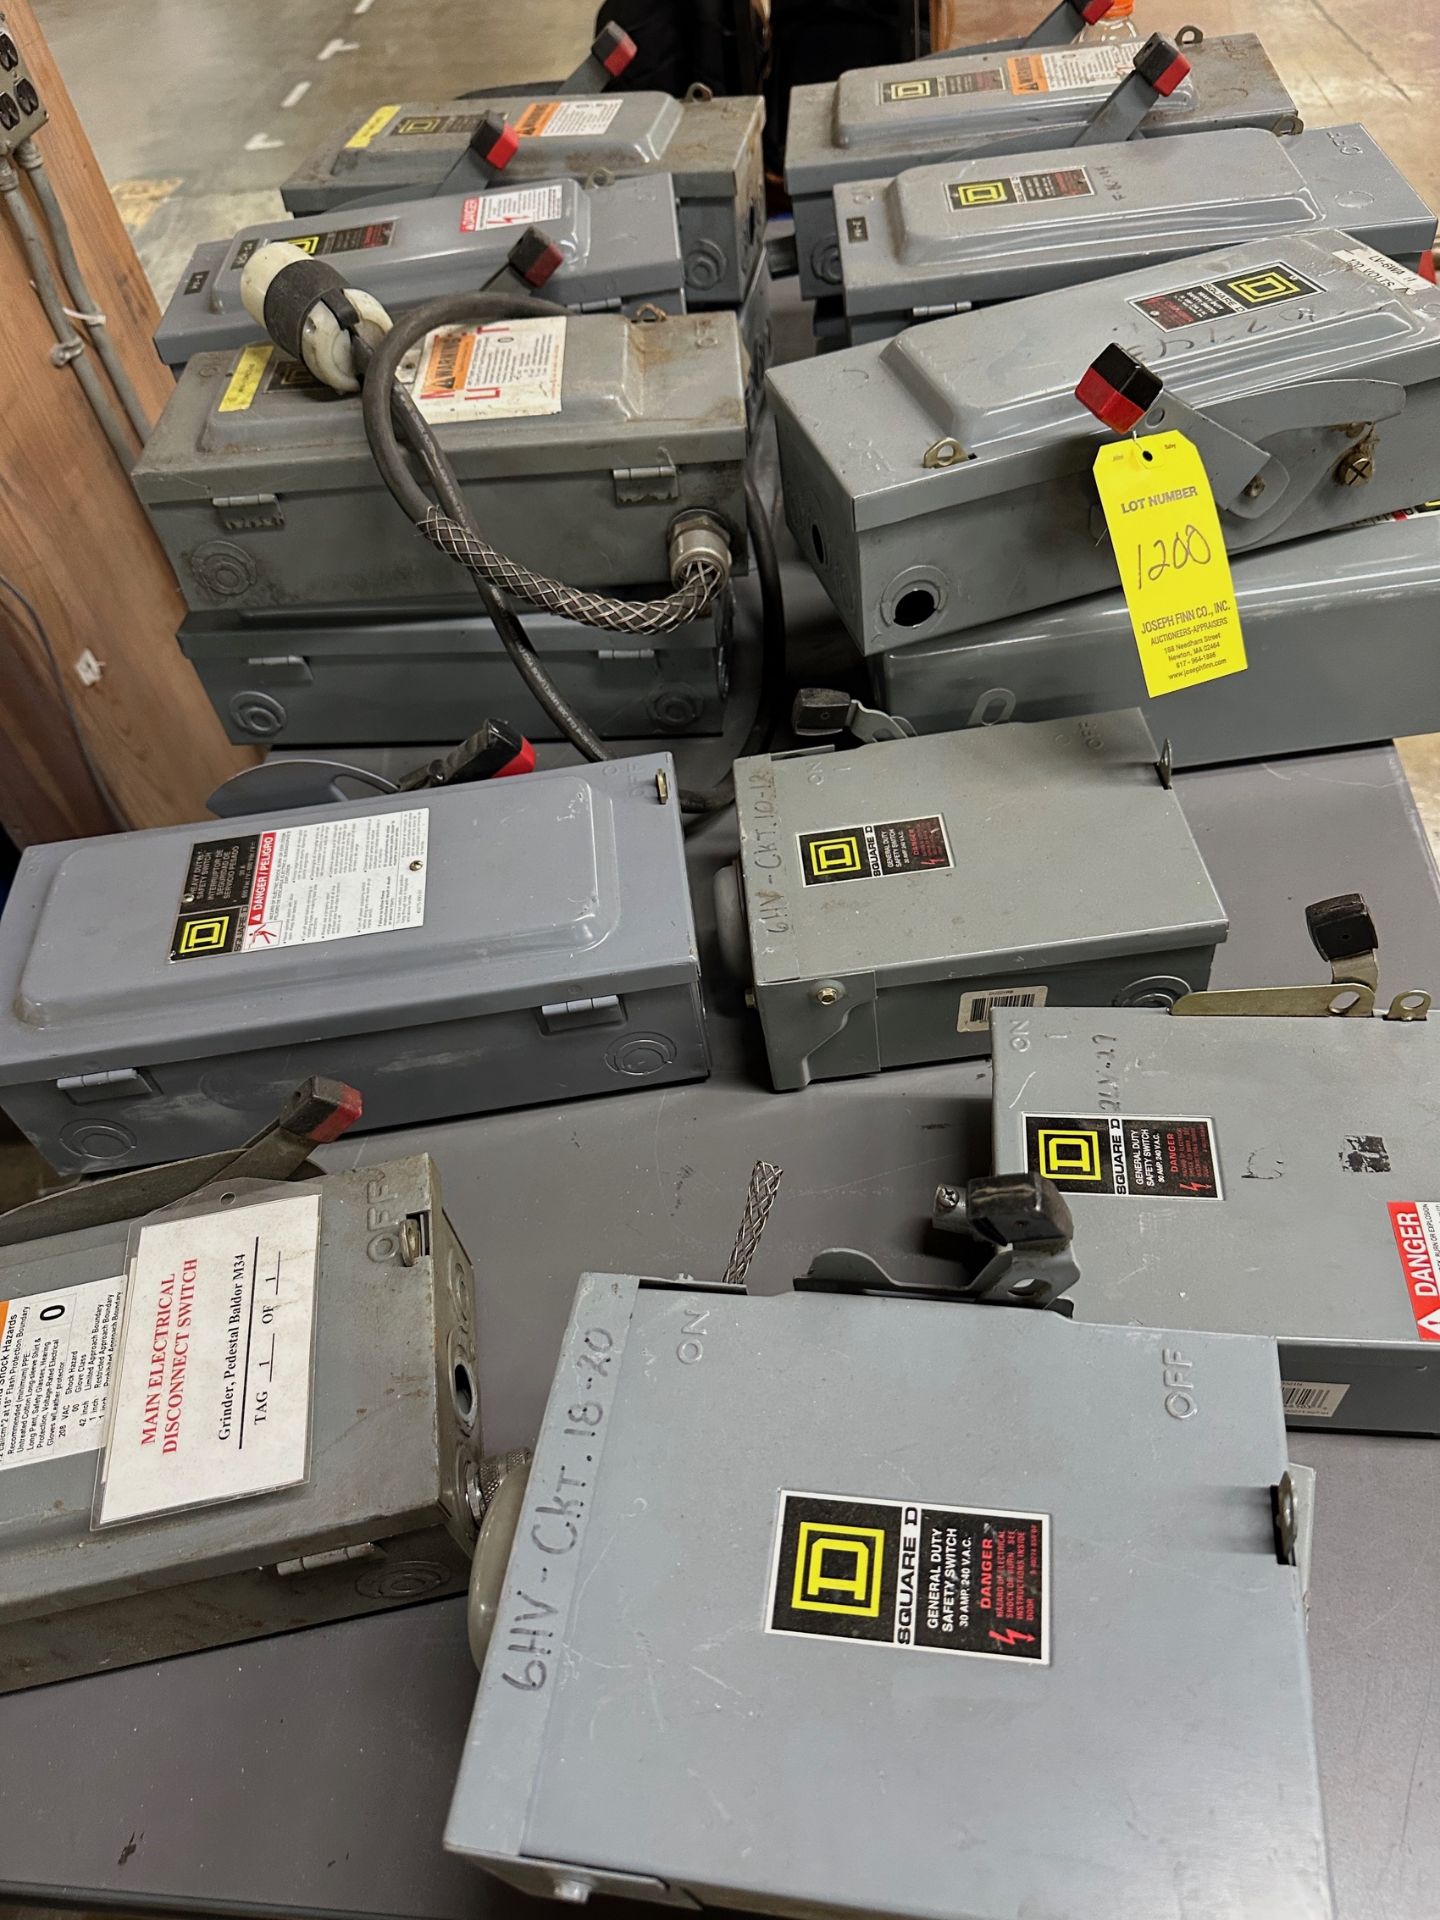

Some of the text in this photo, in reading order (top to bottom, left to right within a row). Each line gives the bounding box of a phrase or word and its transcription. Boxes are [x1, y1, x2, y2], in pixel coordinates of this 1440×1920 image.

[1202, 283, 1238, 308] SQUARE
[1121, 486, 1198, 514] LOT NUMBER
[1137, 524, 1212, 590] 1200
[1141, 600, 1231, 634] JOSEPH FINN CO., INC.
[1150, 617, 1228, 646] AUCTIONEERS-APPRAISERS
[1168, 650, 1192, 662] Newton,
[1193, 646, 1203, 656] MA
[1176, 638, 1203, 650] Needham
[1203, 632, 1221, 643] Street
[1168, 658, 1227, 680] www.josephfinn.com
[1176, 661, 1186, 669] 617
[864, 825, 881, 878] SQUARE D
[253, 877, 267, 911] DANGER
[261, 836, 274, 872] PELIGRO
[234, 915, 248, 952] SQUARE
[1110, 1118, 1129, 1196] SQUARE D
[1131, 1129, 1143, 1184] GENERAL DUTY
[1140, 1128, 1154, 1186] SAFETY SWITCH
[1165, 1132, 1178, 1172] DANGER
[1396, 1212, 1438, 1297] DANGER
[16, 1307, 30, 1338] Boundary
[40, 1305, 65, 1321] 0
[102, 1294, 114, 1323] Boundary
[112, 1292, 123, 1321] Boundary
[2, 1314, 17, 1352] Hazards
[98, 1324, 108, 1355] Approach
[218, 1253, 246, 1441] Grinder, Pedestal Baldor M34
[254, 1275, 277, 1426] TAG 1 OF 1
[676, 1310, 711, 1365] ON
[9, 1339, 22, 1374] Protection
[40, 1341, 51, 1366] Hearing
[78, 1354, 87, 1372] Class
[79, 1304, 104, 1426] 42 inch Limited Approach Boundary
[94, 1356, 105, 1388] Restricted
[140, 1272, 176, 1447] MAIN ELECTRICAL
[162, 1257, 199, 1454] DISCONNECT SWITCH
[6, 1375, 15, 1395] Flash
[17, 1420, 27, 1453] Untreated
[22, 1398, 31, 1419] Cotton
[32, 1343, 41, 1359] Shirt
[36, 1366, 46, 1393] Glasses,
[36, 1339, 59, 1448] Protection, Voltage-Rated Electrical
[58, 1350, 78, 1438] 208 VAC Shock Hazard
[75, 1374, 84, 1393] Glove
[1162, 1347, 1198, 1420] OFF
[32, 1393, 43, 1414] Safety
[47, 1423, 56, 1446] Gloves
[56, 1362, 65, 1390] protector
[90, 1398, 99, 1413] inch
[7, 1404, 21, 1454] Recommended
[26, 1433, 37, 1450] Long
[996, 1529, 1005, 1573] ELECTRICAL
[897, 1507, 919, 1646] SQUARE D
[926, 1527, 943, 1628] GENERAL DUTY
[941, 1527, 957, 1632] SAFETY SWITCH
[959, 1535, 971, 1626] 30 AMP. 240 V.A.C.
[979, 1537, 993, 1608] DANGER
[1015, 1530, 1025, 1619] INSTRUCTIONS INSIDE
[995, 1586, 1004, 1617] HAZARD
[1005, 1591, 1014, 1618] SHOCK
[1026, 1597, 1034, 1620] DOOR
[501, 1591, 559, 1692] 6HV
